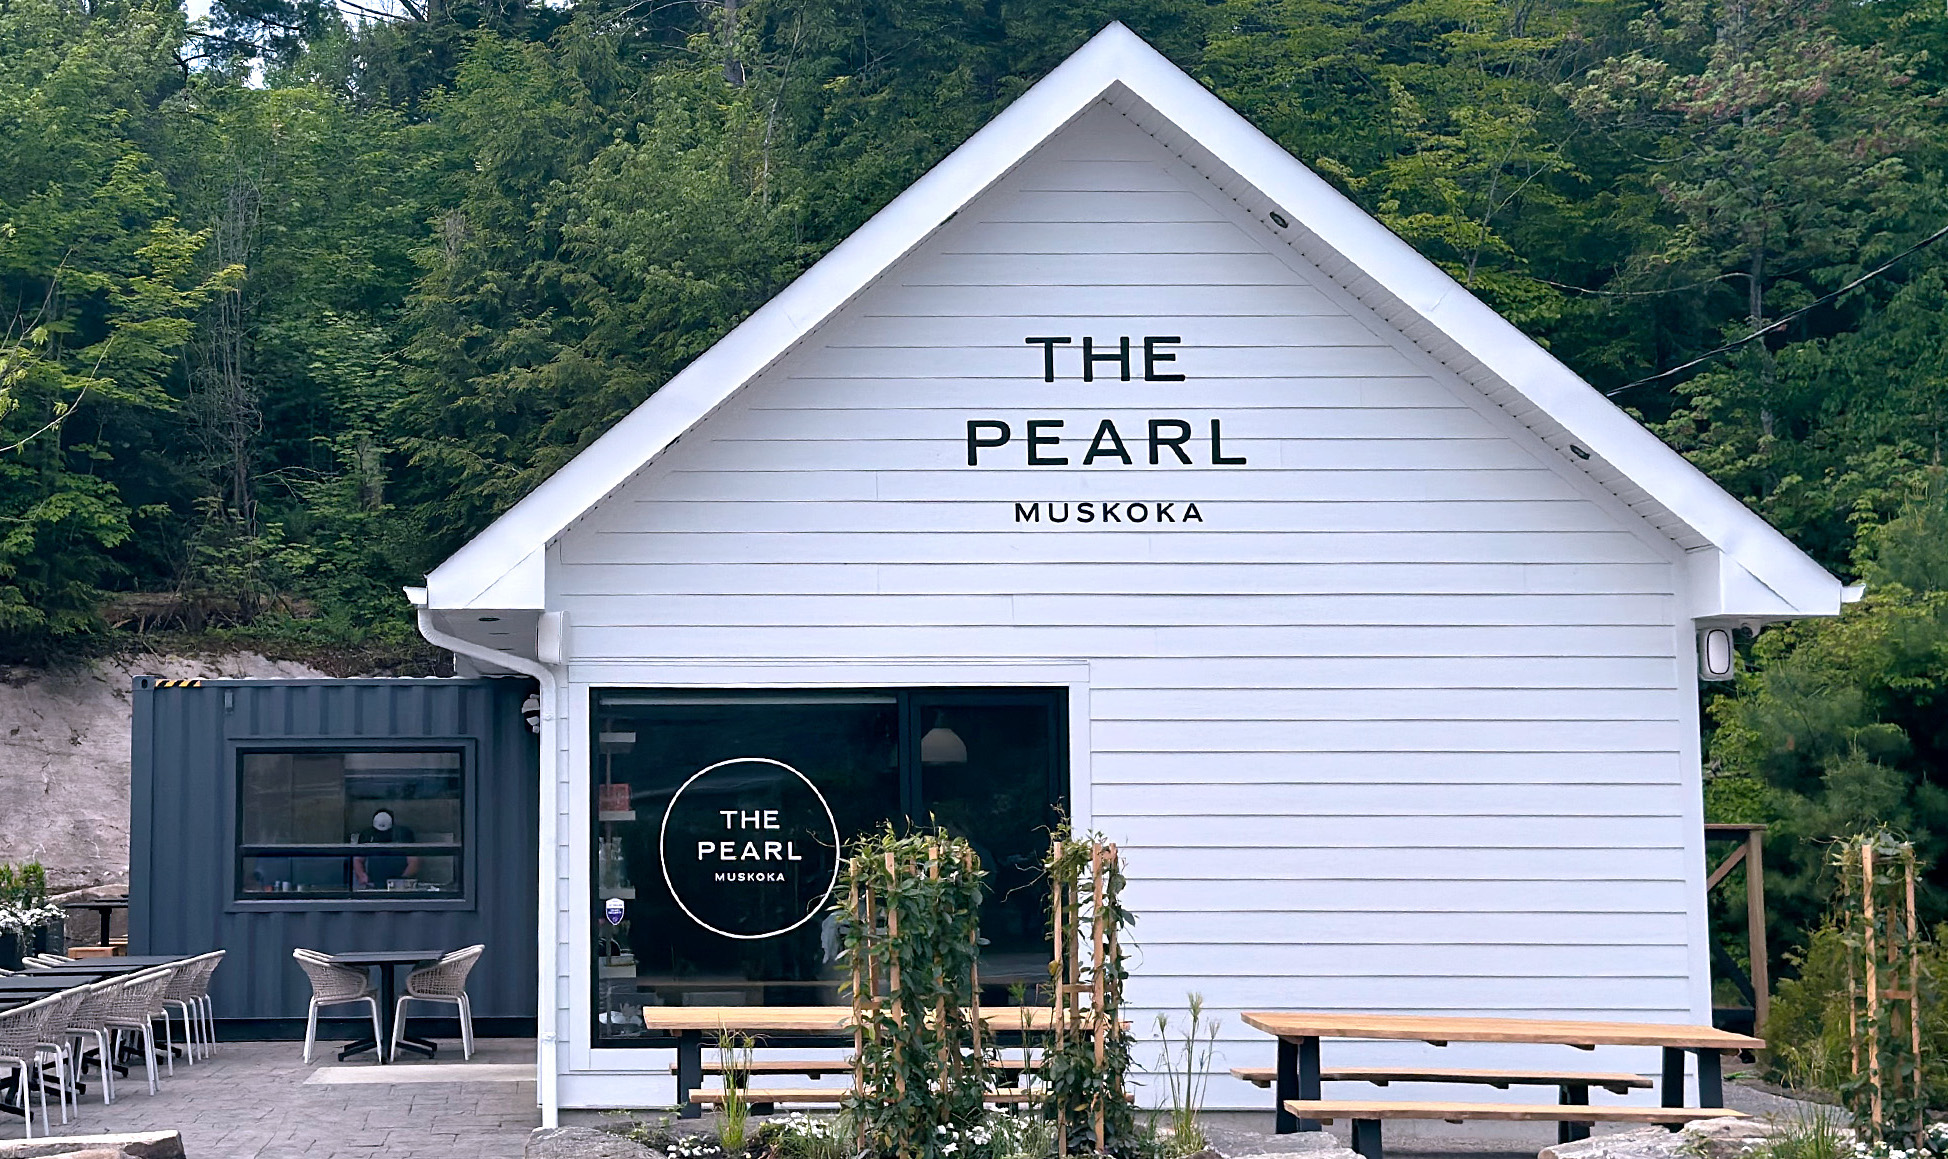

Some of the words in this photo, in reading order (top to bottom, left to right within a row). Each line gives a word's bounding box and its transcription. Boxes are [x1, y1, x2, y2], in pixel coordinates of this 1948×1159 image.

[1025, 336, 1186, 383] THE
[966, 419, 1247, 466] PEARL
[1015, 502, 1204, 523] MUSKOKA
[719, 809, 780, 830] THE
[698, 841, 802, 861] PEARL
[715, 872, 785, 882] MUSKOKA
